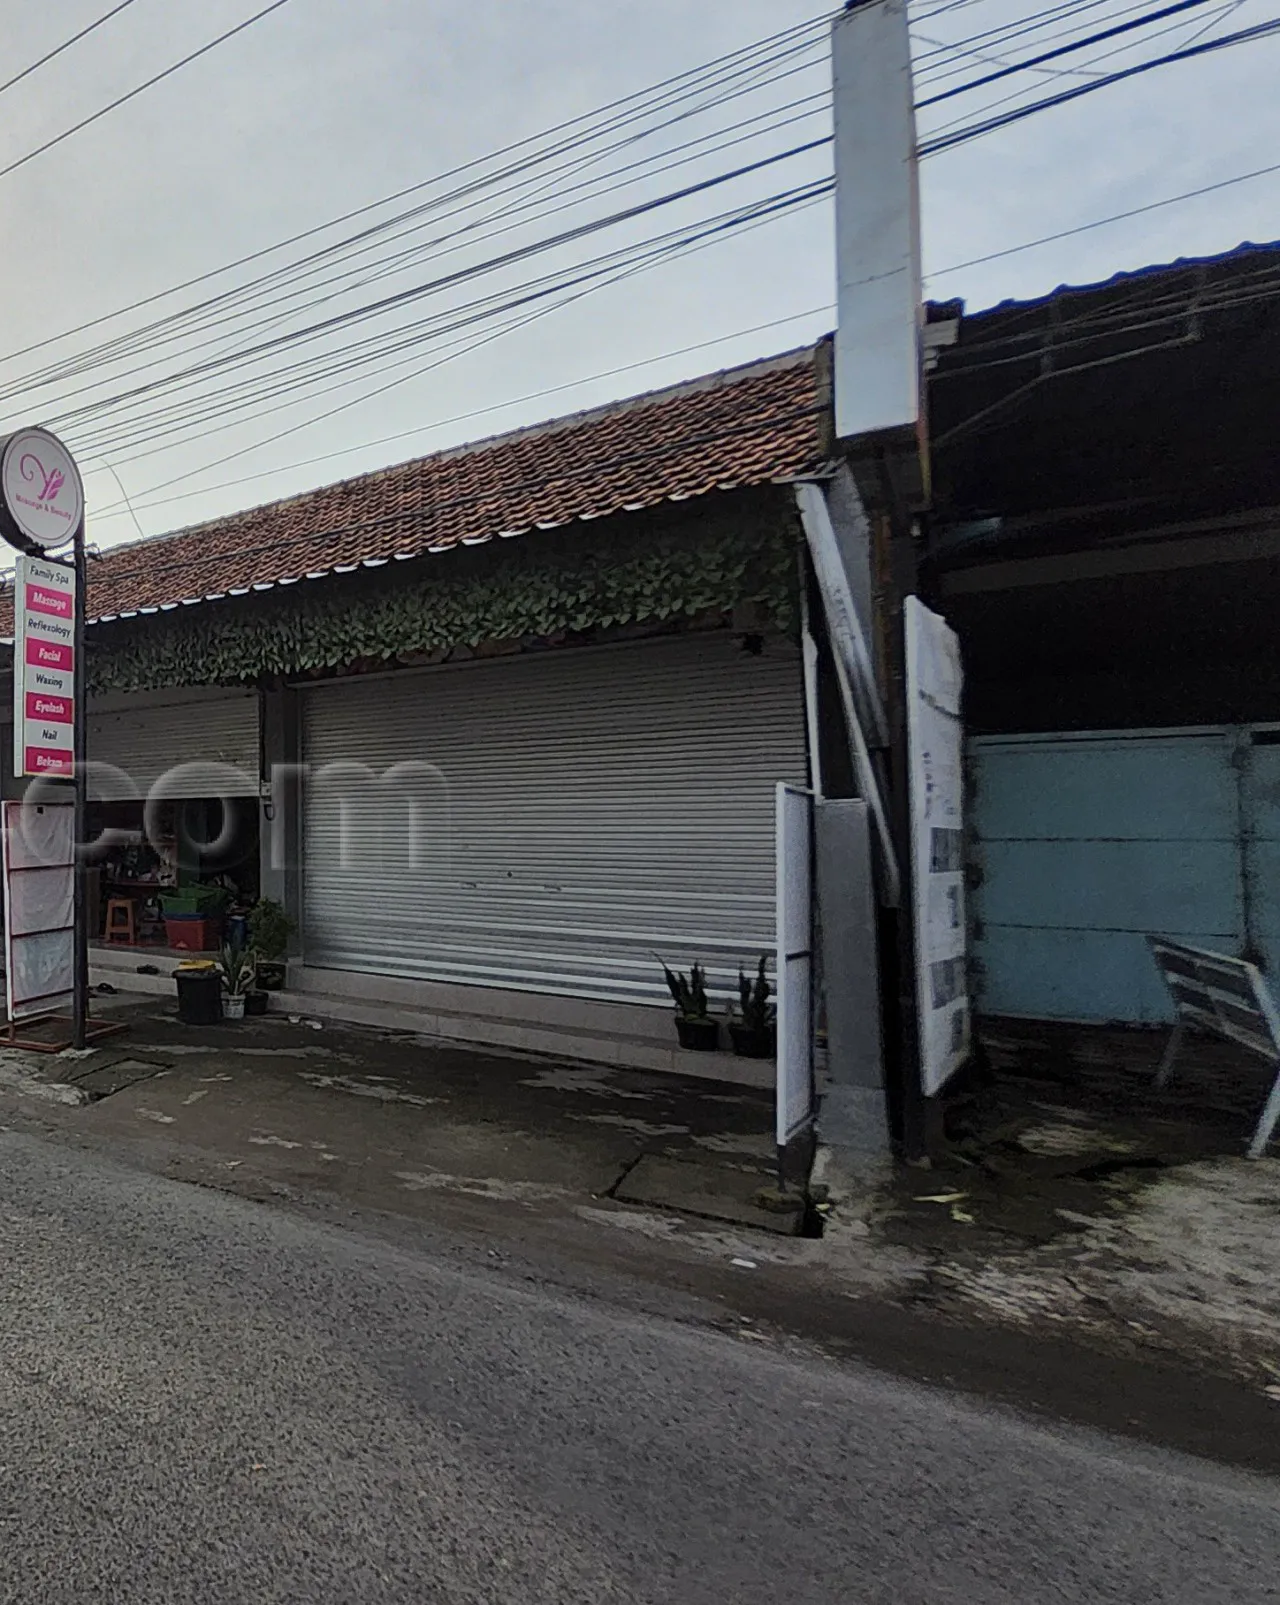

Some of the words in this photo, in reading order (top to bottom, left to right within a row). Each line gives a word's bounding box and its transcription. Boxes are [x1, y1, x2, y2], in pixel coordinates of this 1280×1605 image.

[30, 565, 54, 582] Family
[55, 571, 69, 585] Spa
[32, 591, 67, 610] Massage
[27, 617, 71, 638] Reflexology
[38, 648, 62, 662] Facial
[35, 673, 63, 689] Waxing
[34, 700, 65, 716] Eyelash
[42, 729, 58, 741] Nail
[36, 755, 63, 770] Bekam
